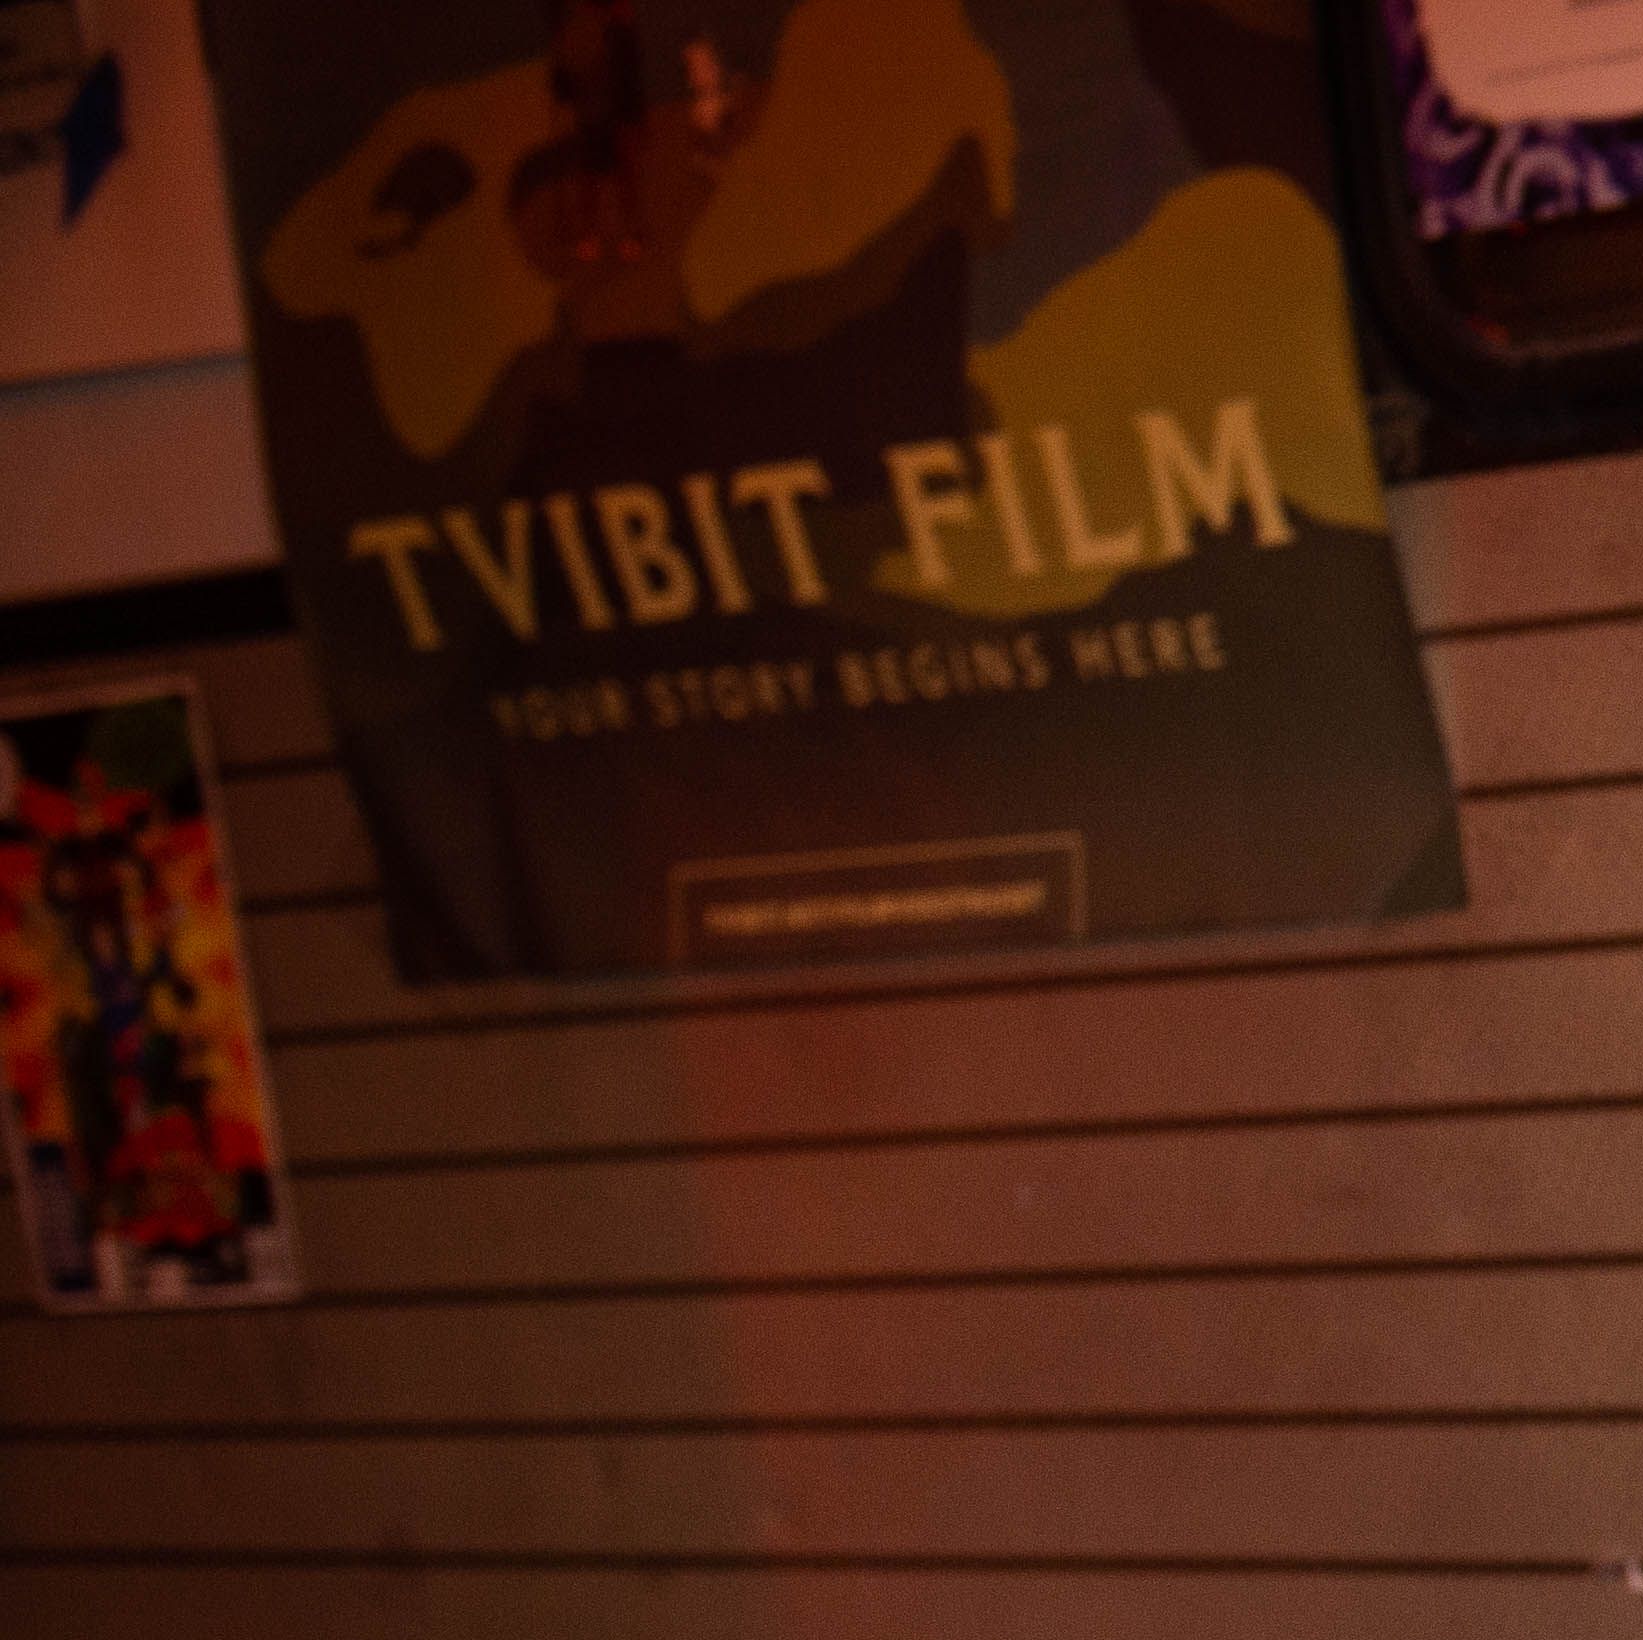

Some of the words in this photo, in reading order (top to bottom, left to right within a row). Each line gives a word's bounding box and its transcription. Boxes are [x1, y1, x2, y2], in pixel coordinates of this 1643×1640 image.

[349, 456, 832, 652] TVIBIT
[884, 401, 1296, 588] FILM
[490, 676, 634, 742] YOUR
[645, 656, 816, 728] STORY
[837, 632, 1050, 706] BEGINS
[1069, 612, 1228, 681] HERE
